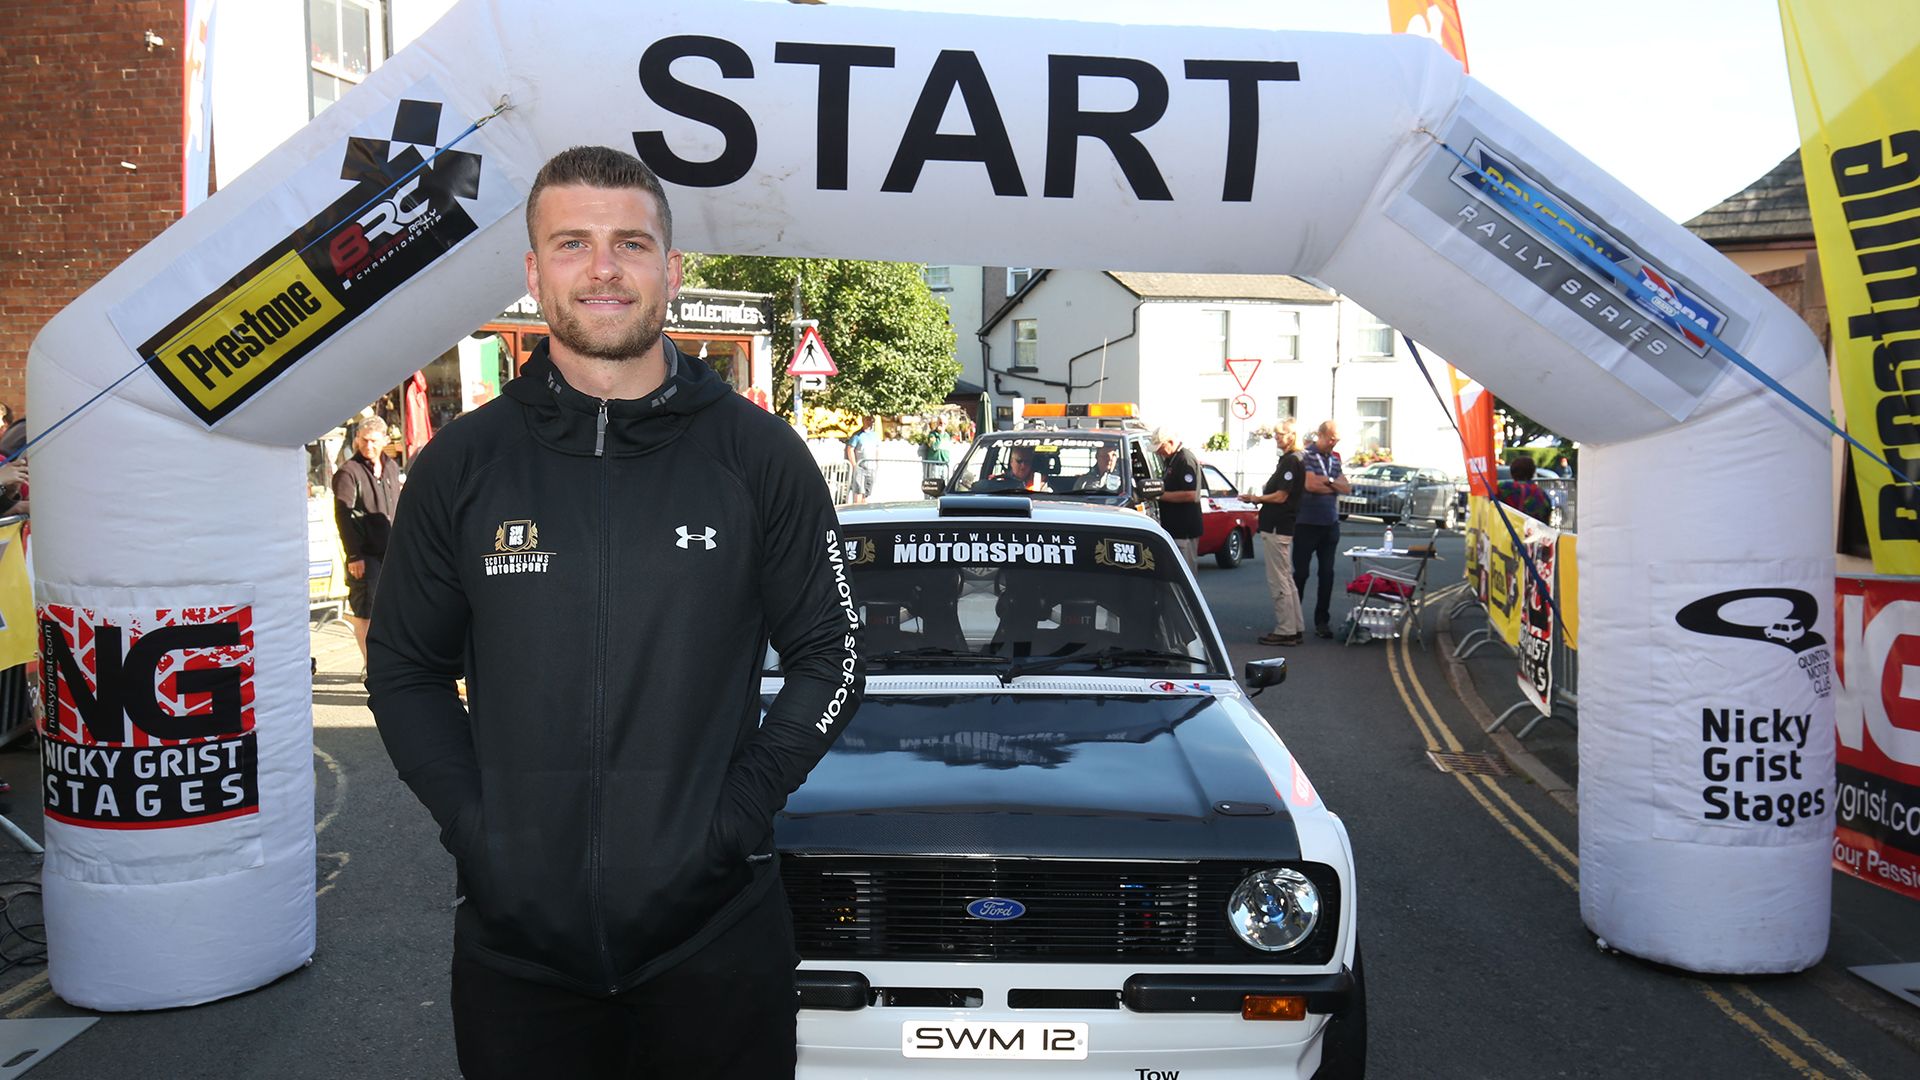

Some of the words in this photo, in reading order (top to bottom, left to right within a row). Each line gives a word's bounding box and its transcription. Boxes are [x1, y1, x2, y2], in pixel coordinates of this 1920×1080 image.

[632, 35, 1300, 202] START
[329, 174, 430, 277] BRC
[408, 208, 437, 233] RALLY
[356, 215, 442, 280] CHAMPIONSHIP
[1458, 205, 1552, 270] RALLY
[1561, 279, 1668, 355] SERIES
[681, 302, 759, 324] COLLECTABLES
[176, 280, 322, 391] Prestone
[991, 439, 1041, 448] Acorn
[1043, 438, 1105, 448] Leisure
[508, 535, 524, 546] MS
[509, 525, 525, 537] SW
[894, 532, 960, 543] SCOTT
[969, 532, 1076, 545] WILLIAMS
[484, 555, 506, 567] SCOTT
[508, 554, 549, 564] WILLIAMS
[893, 542, 1077, 565] MOTORSPORT
[1113, 542, 1135, 555] SW
[1114, 552, 1137, 565] MS
[485, 562, 549, 576] MOTORSPORT
[40, 621, 243, 743] NG
[47, 623, 58, 730] nickygrist.com
[1702, 707, 1812, 749] Nicky
[44, 739, 121, 778] NICKY
[133, 740, 243, 778] GRIST
[1703, 746, 1802, 783] Grist
[46, 773, 245, 818] STAGES
[1702, 785, 1825, 828] Stages
[979, 901, 1013, 918] Ford
[915, 1027, 1025, 1051] SWM
[1042, 1029, 1076, 1051] 12
[1134, 1068, 1180, 1080] Tow
